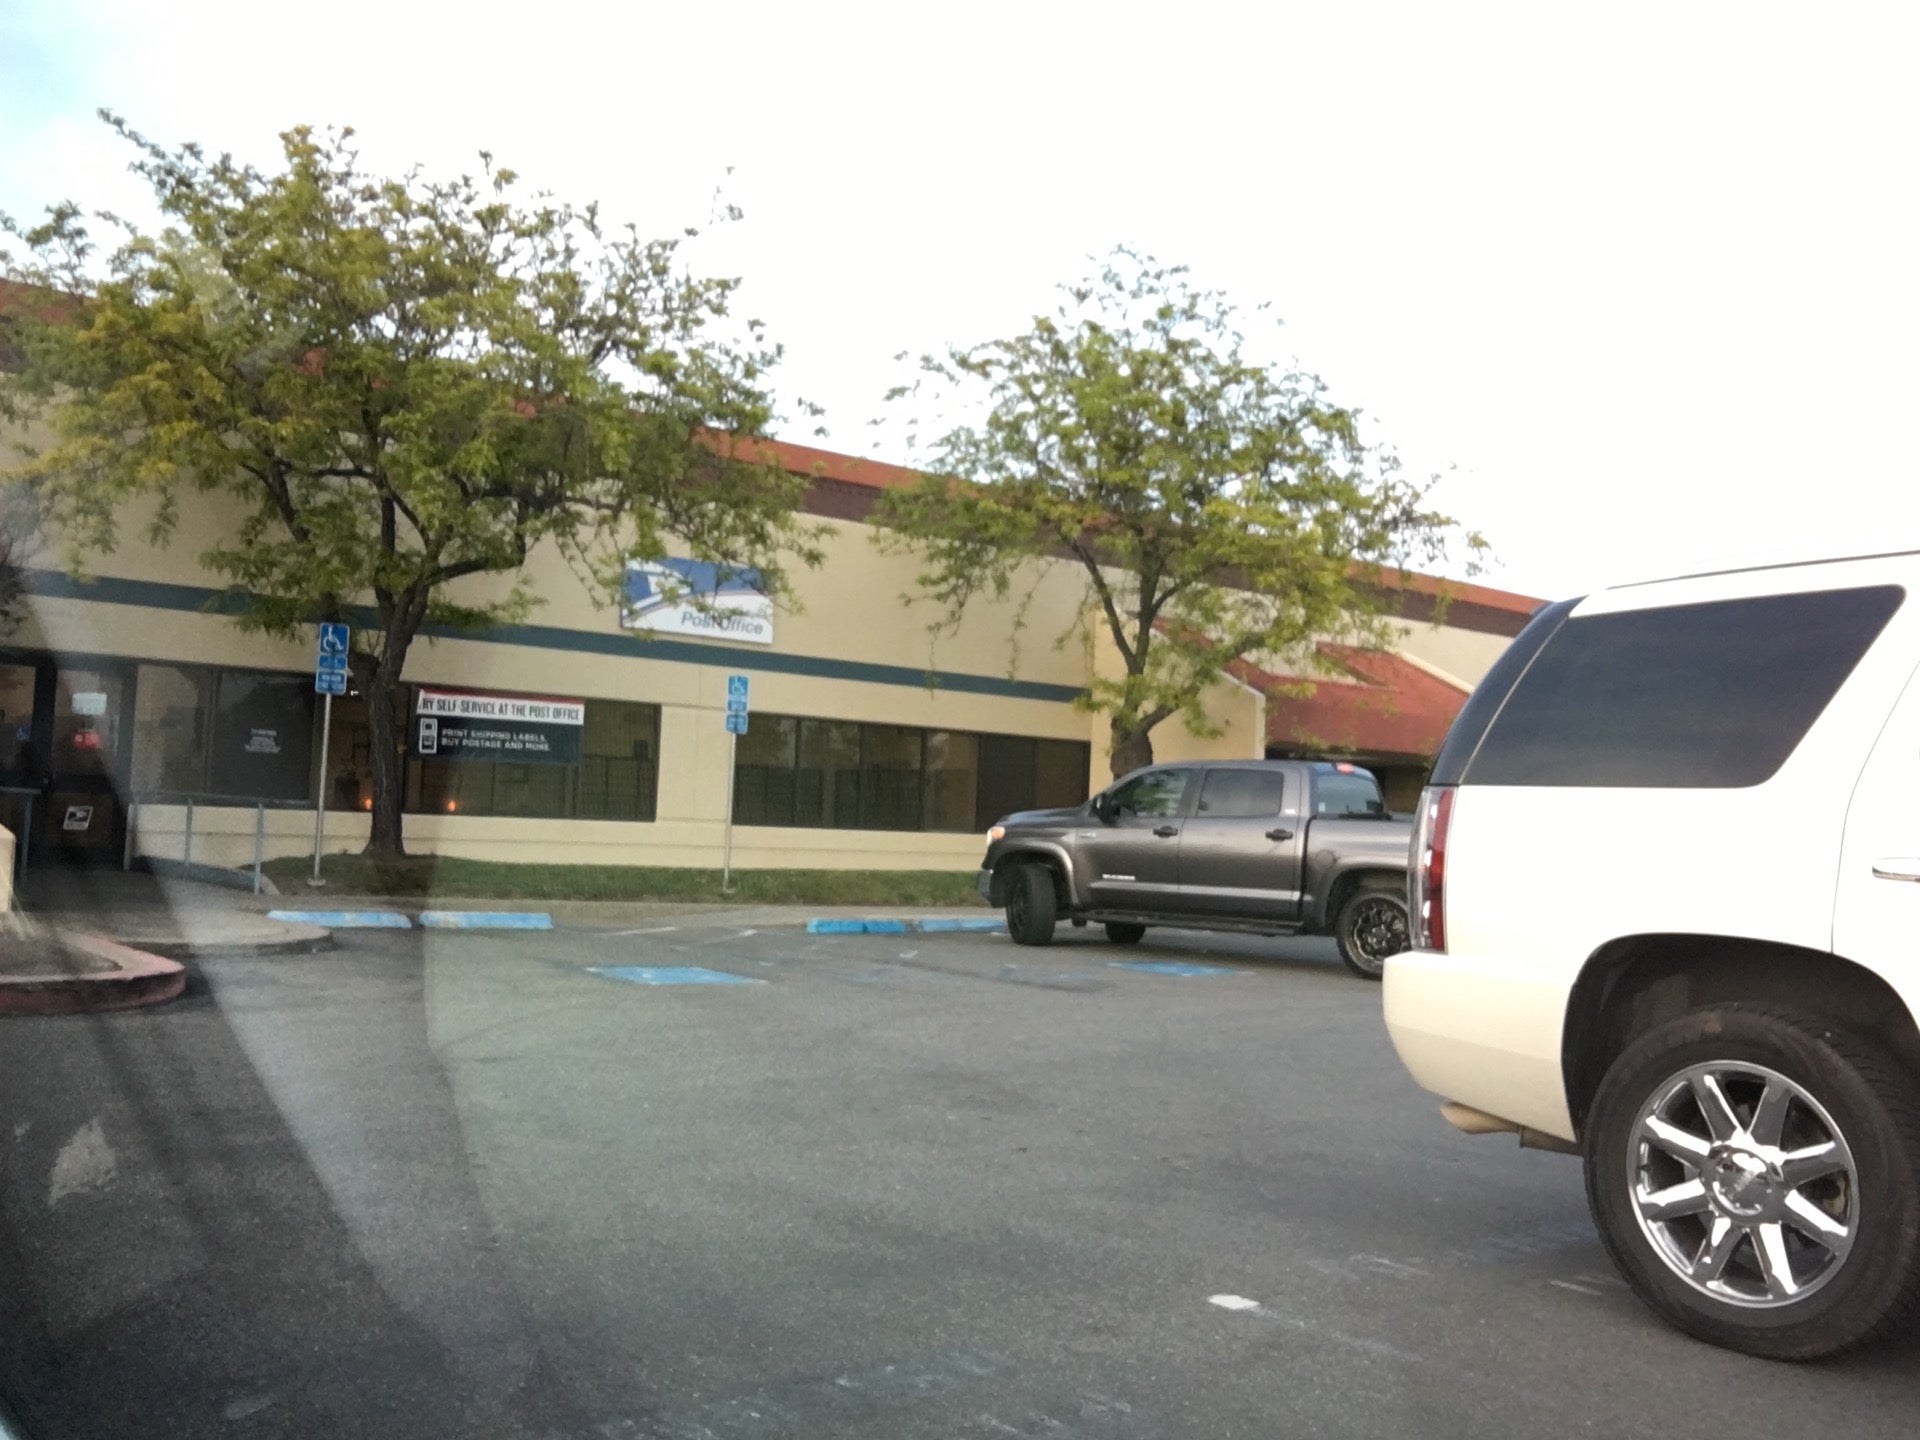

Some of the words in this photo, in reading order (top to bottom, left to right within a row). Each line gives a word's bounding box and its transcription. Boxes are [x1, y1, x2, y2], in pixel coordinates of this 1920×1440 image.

[682, 611, 715, 628] Post
[720, 615, 763, 634] Office
[437, 698, 456, 711] SELF
[460, 699, 495, 715] SERVICE
[498, 702, 509, 715] AT
[511, 703, 526, 717] THE
[529, 705, 550, 718] POST
[552, 707, 579, 721] OFFICE
[442, 728, 468, 737] PRINT
[471, 729, 511, 740] SHIPPING
[441, 737, 460, 746] BUY
[462, 738, 501, 748] POSTAGE
[504, 740, 523, 749] AND
